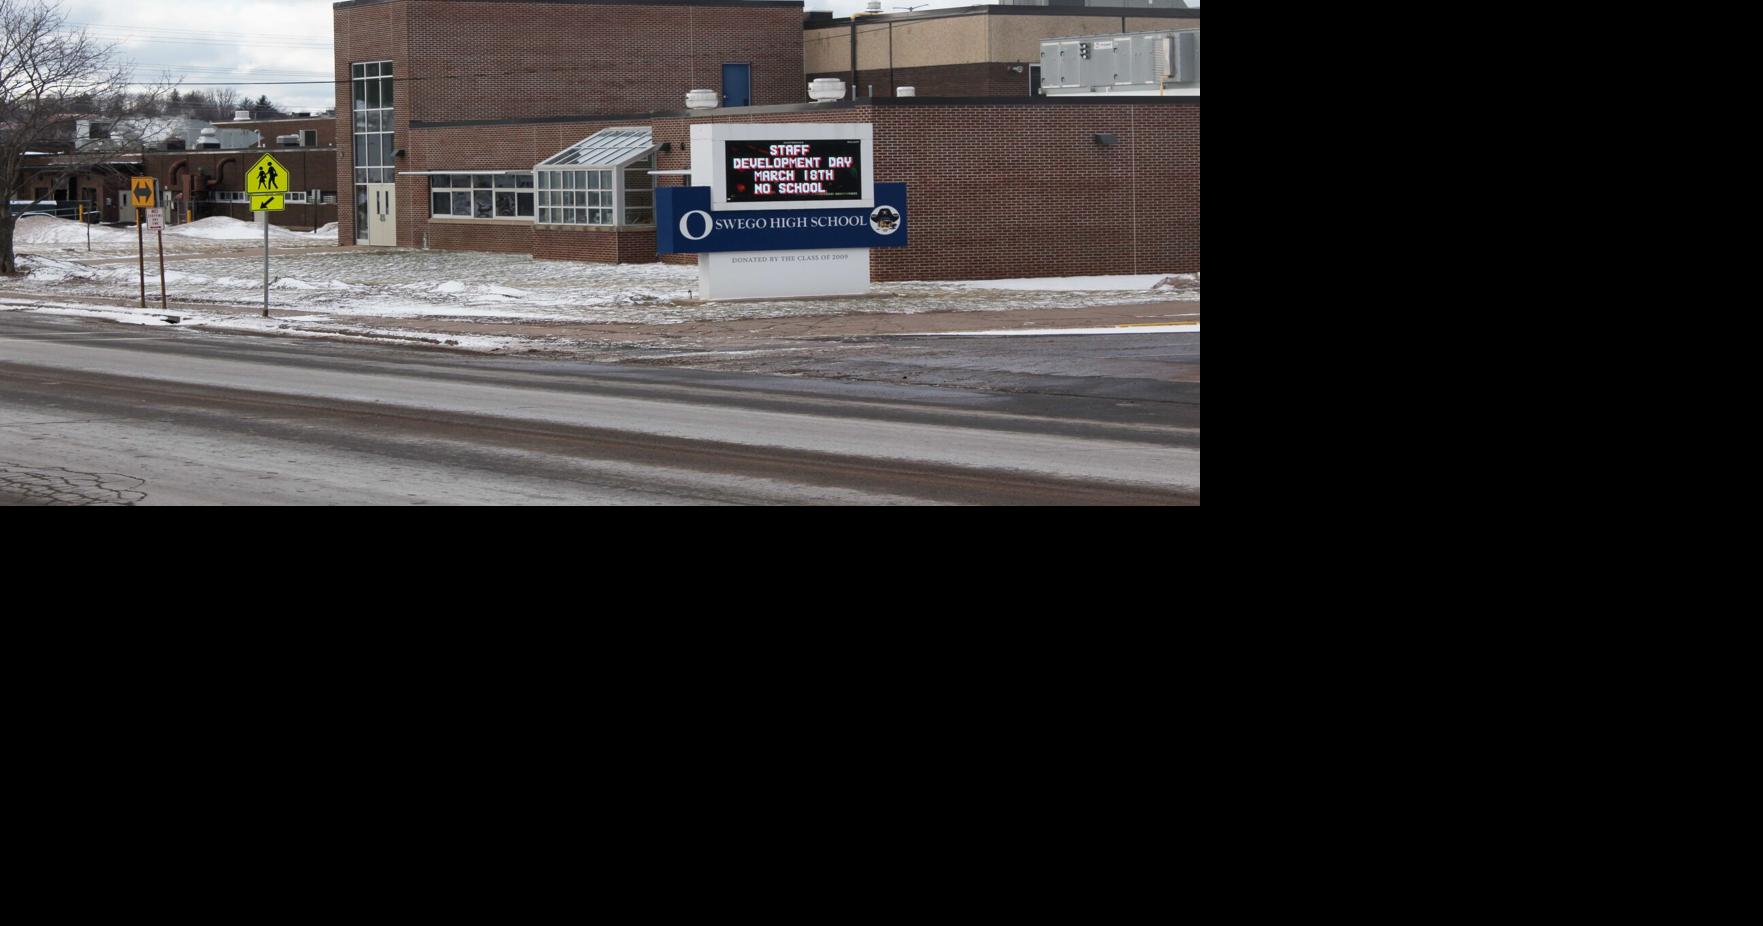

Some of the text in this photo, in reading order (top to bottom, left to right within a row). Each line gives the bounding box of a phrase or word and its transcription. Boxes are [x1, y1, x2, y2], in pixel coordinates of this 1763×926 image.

[769, 144, 810, 156] STAFF
[733, 156, 852, 169] DEVELOPMENT DAY
[754, 169, 834, 181] MARCH 18TH
[754, 182, 826, 194] NO SCHOOL
[770, 217, 807, 228] HIGH
[810, 215, 867, 227] SCHOOL
